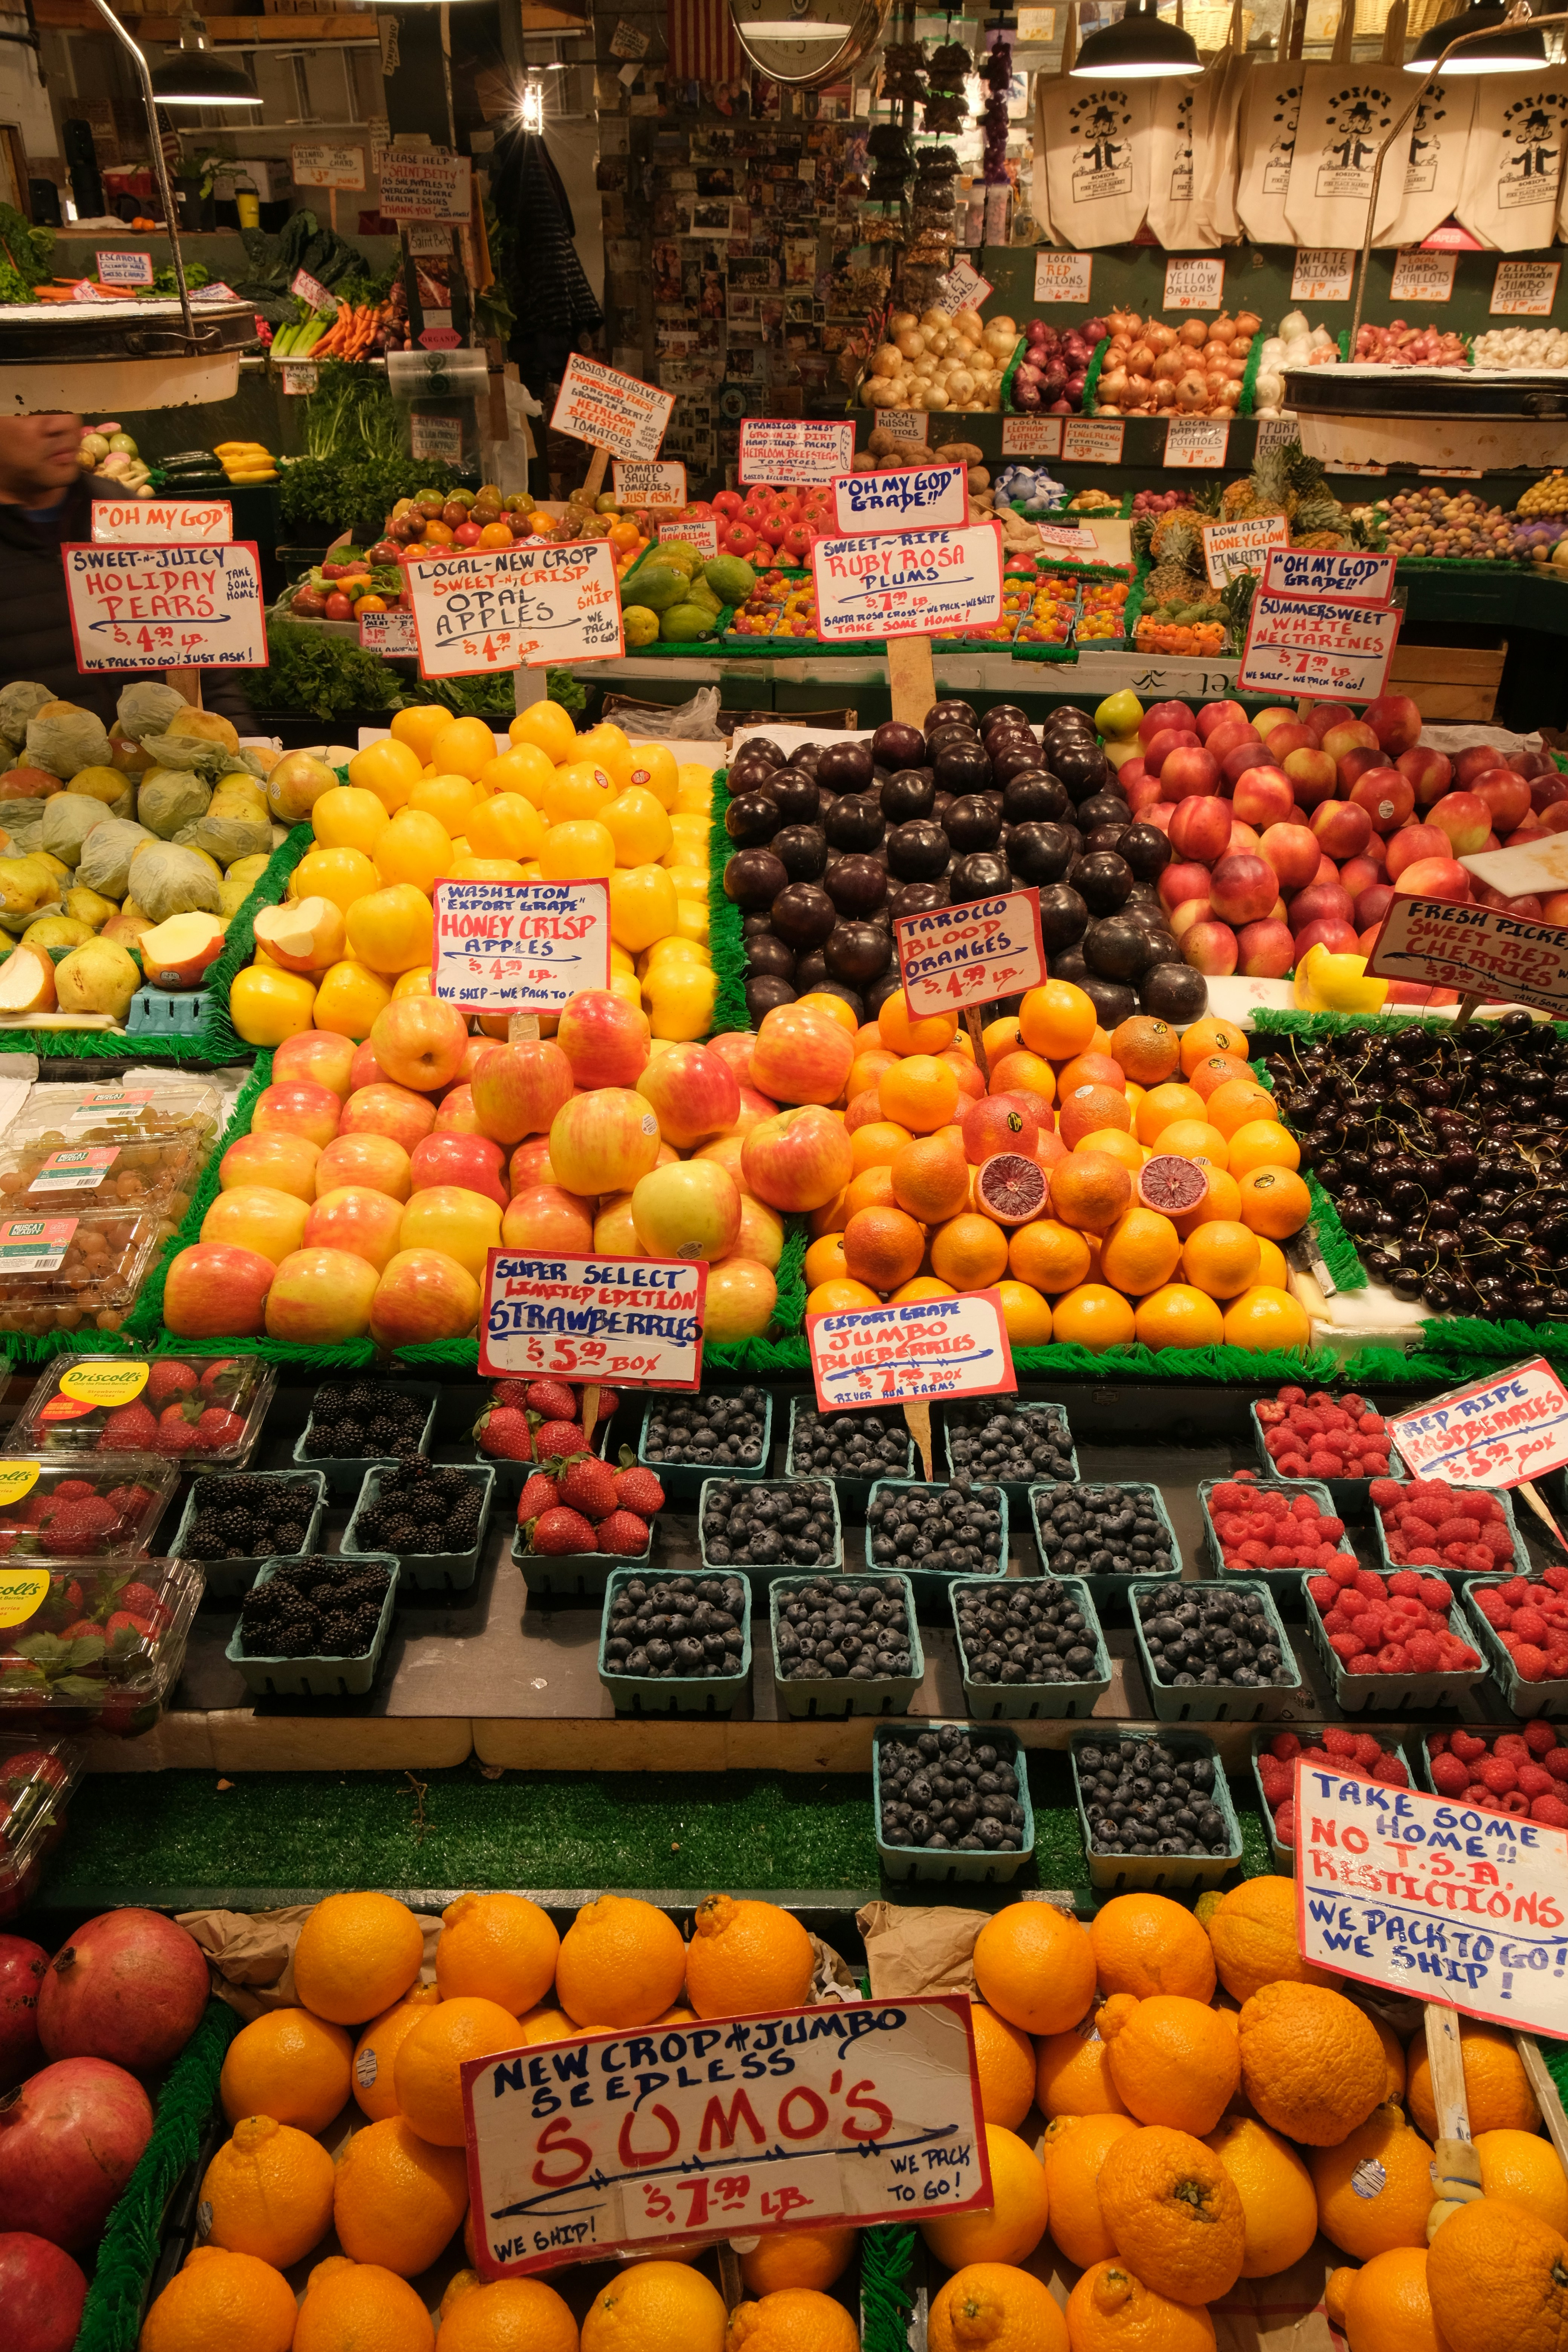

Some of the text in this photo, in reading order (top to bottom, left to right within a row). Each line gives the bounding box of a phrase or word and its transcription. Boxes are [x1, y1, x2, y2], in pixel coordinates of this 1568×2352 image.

[383, 153, 418, 164] PLEASE
[385, 196, 447, 206] HEALTH ISSUES
[382, 205, 413, 214] THANK
[411, 234, 451, 248] Saint Betty
[1427, 234, 1461, 243] STAPLES
[99, 254, 143, 263] ESCAROLE
[1048, 255, 1079, 263] LOCAL
[1300, 252, 1347, 263] WHITE
[1045, 265, 1071, 276] RED
[1175, 262, 1211, 270] LOCAL
[1294, 265, 1347, 279] ONIONS
[1400, 265, 1438, 273] JUMBO
[1504, 264, 1548, 273] GILROY
[1037, 276, 1083, 286] ONIONS
[1170, 273, 1218, 284] YELLOW
[1394, 271, 1449, 285] SHALLOTS
[1501, 280, 1545, 291] JUMBO
[1167, 285, 1213, 295] ONIONS
[1496, 289, 1542, 299] GARLIC
[422, 335, 458, 343] ORGANIC
[576, 398, 636, 428] HEIRLOOM
[565, 405, 633, 438] BEEFSTEAK
[878, 419, 917, 428] RUSSET
[572, 416, 631, 448] TOMATOES
[1067, 430, 1120, 442] FINGERLING
[1170, 427, 1199, 436] BABY
[1069, 438, 1110, 447] POTATOES
[1169, 436, 1222, 448] POTATOES
[742, 448, 839, 464] HEIRLOOM BEEFSTEAK
[619, 464, 664, 474] TOMATO
[625, 473, 659, 483] SAUCE
[619, 482, 671, 491] TOMATOES
[622, 493, 647, 504] JUST
[682, 523, 706, 532] ROYAL
[1212, 519, 1276, 537] LOW ACID
[661, 531, 710, 542] HAWAIIAN
[543, 546, 598, 567] CROP
[824, 545, 965, 583] RUBY ROSA
[85, 569, 217, 595] HOLIDAY
[859, 567, 939, 590] PLUMS
[97, 594, 215, 621] PEARS
[446, 588, 537, 613] OPAL
[436, 602, 554, 637] APPLES
[824, 615, 854, 626] SANTA
[858, 611, 884, 621] ROSA
[1260, 597, 1388, 626] SUMMERSWEET
[833, 622, 875, 634] TAKE
[882, 618, 918, 632] SOME
[1272, 617, 1353, 635] WHITE
[1255, 627, 1384, 653] NECTARINES
[86, 659, 105, 669] WE
[106, 656, 138, 668] PACK
[139, 657, 156, 666] TO
[182, 654, 215, 664] JUST
[447, 885, 570, 899] WASHINTON
[901, 900, 1008, 936] TAROCCO
[1408, 902, 1489, 927] FRESH
[441, 914, 597, 940] HONEY CRISP
[465, 939, 554, 956] APPLES
[903, 920, 1001, 962] BLOOD
[1406, 918, 1561, 967] SWEET RED
[905, 932, 1012, 978] ORANGES
[1405, 937, 1553, 987] CHERRIES
[1513, 994, 1562, 1011] TAKE SOME
[495, 1259, 688, 1289] SUPER SELECT
[505, 1277, 697, 1310] LIMITED EDITION
[488, 1299, 704, 1342] STRAWBERRIES
[829, 1321, 948, 1351] JUMBO
[817, 1334, 975, 1382] BLUEBERRIES
[68, 1372, 142, 1382] Driscoll's
[834, 1381, 956, 1403] RIVER RUN FARMS
[1396, 1379, 1529, 1438] RED RIPE
[1404, 1390, 1564, 1462] RASPBERRIES
[1312, 1772, 1541, 1848] TAKE SOME
[1308, 1849, 1565, 1928] RESTICTIONS
[493, 2008, 907, 2098] NEW CROP JUMBO
[531, 2048, 795, 2119] SEEDLESS
[532, 2068, 893, 2187] SUMO'S
